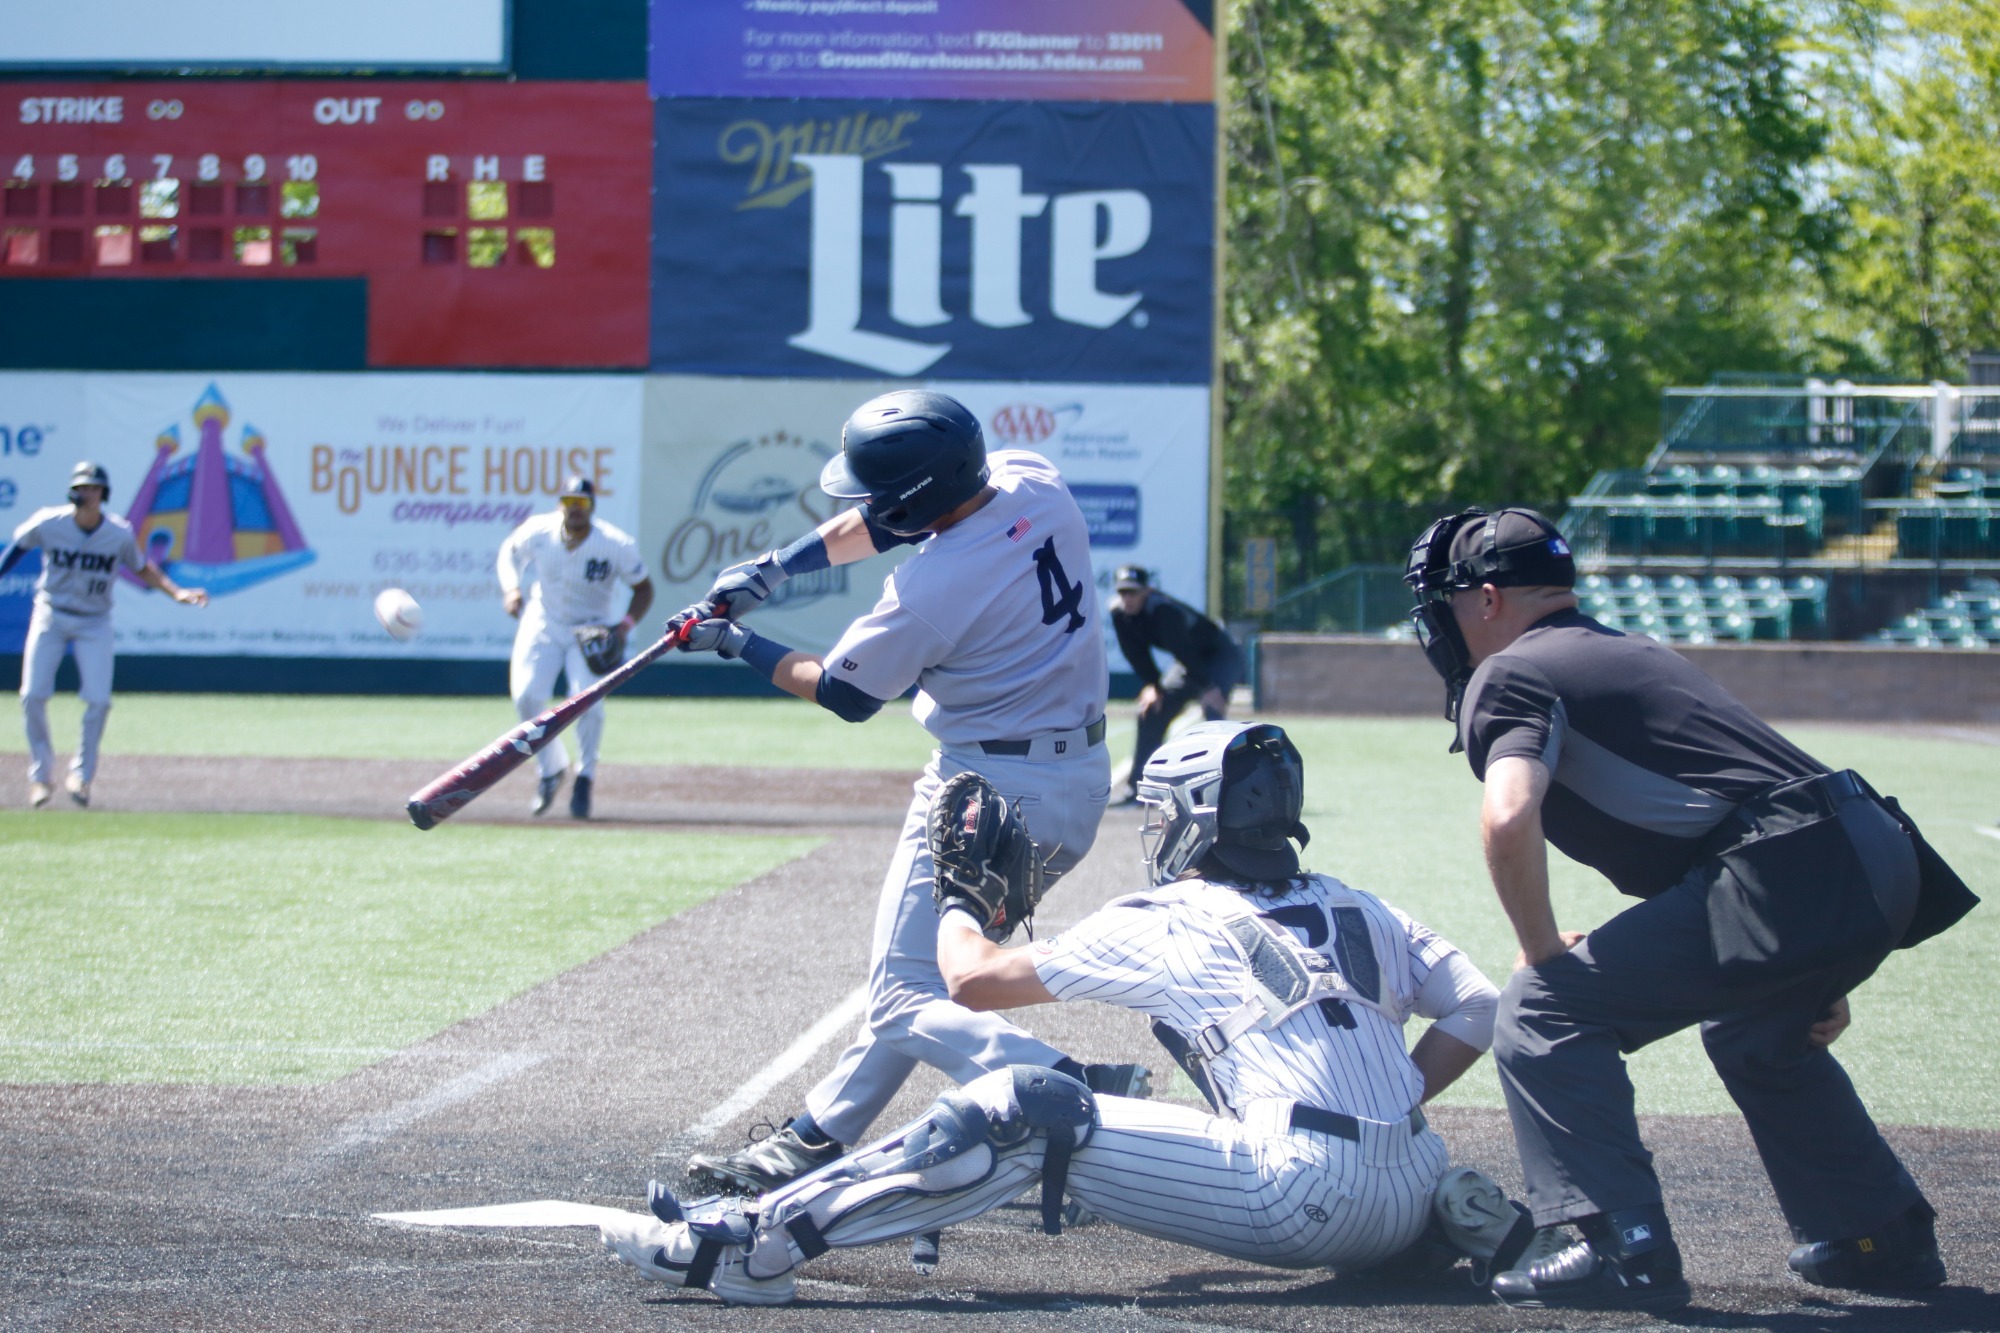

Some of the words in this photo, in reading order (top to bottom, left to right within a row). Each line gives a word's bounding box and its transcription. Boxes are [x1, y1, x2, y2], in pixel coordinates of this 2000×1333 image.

[744, 28, 774, 46] For
[779, 32, 825, 46] more
[1085, 34, 1104, 49] to
[744, 54, 764, 68] or
[768, 54, 794, 73] go
[798, 52, 817, 68] to
[19, 96, 124, 124] STRIKE
[313, 97, 382, 124] OUT
[13, 154, 35, 181] 4
[57, 154, 79, 181] 5
[104, 154, 126, 181] 6
[152, 154, 173, 180] 7
[198, 154, 220, 181] 8
[244, 154, 266, 181] 9
[286, 154, 317, 181] 10
[426, 155, 450, 181] R
[473, 155, 499, 181] H
[522, 155, 546, 182] E
[717, 111, 921, 204] Miller
[787, 154, 1152, 376] Lite
[378, 416, 407, 432] We
[414, 416, 477, 433] Deliver
[485, 416, 526, 433] Fun!
[311, 445, 469, 515] BOUNCE
[484, 446, 615, 496] HOUSE
[391, 500, 537, 526] company
[52, 549, 117, 574] LYON
[373, 551, 498, 573] 636-345-2
[661, 515, 771, 584] One
[1033, 534, 1086, 634] 4
